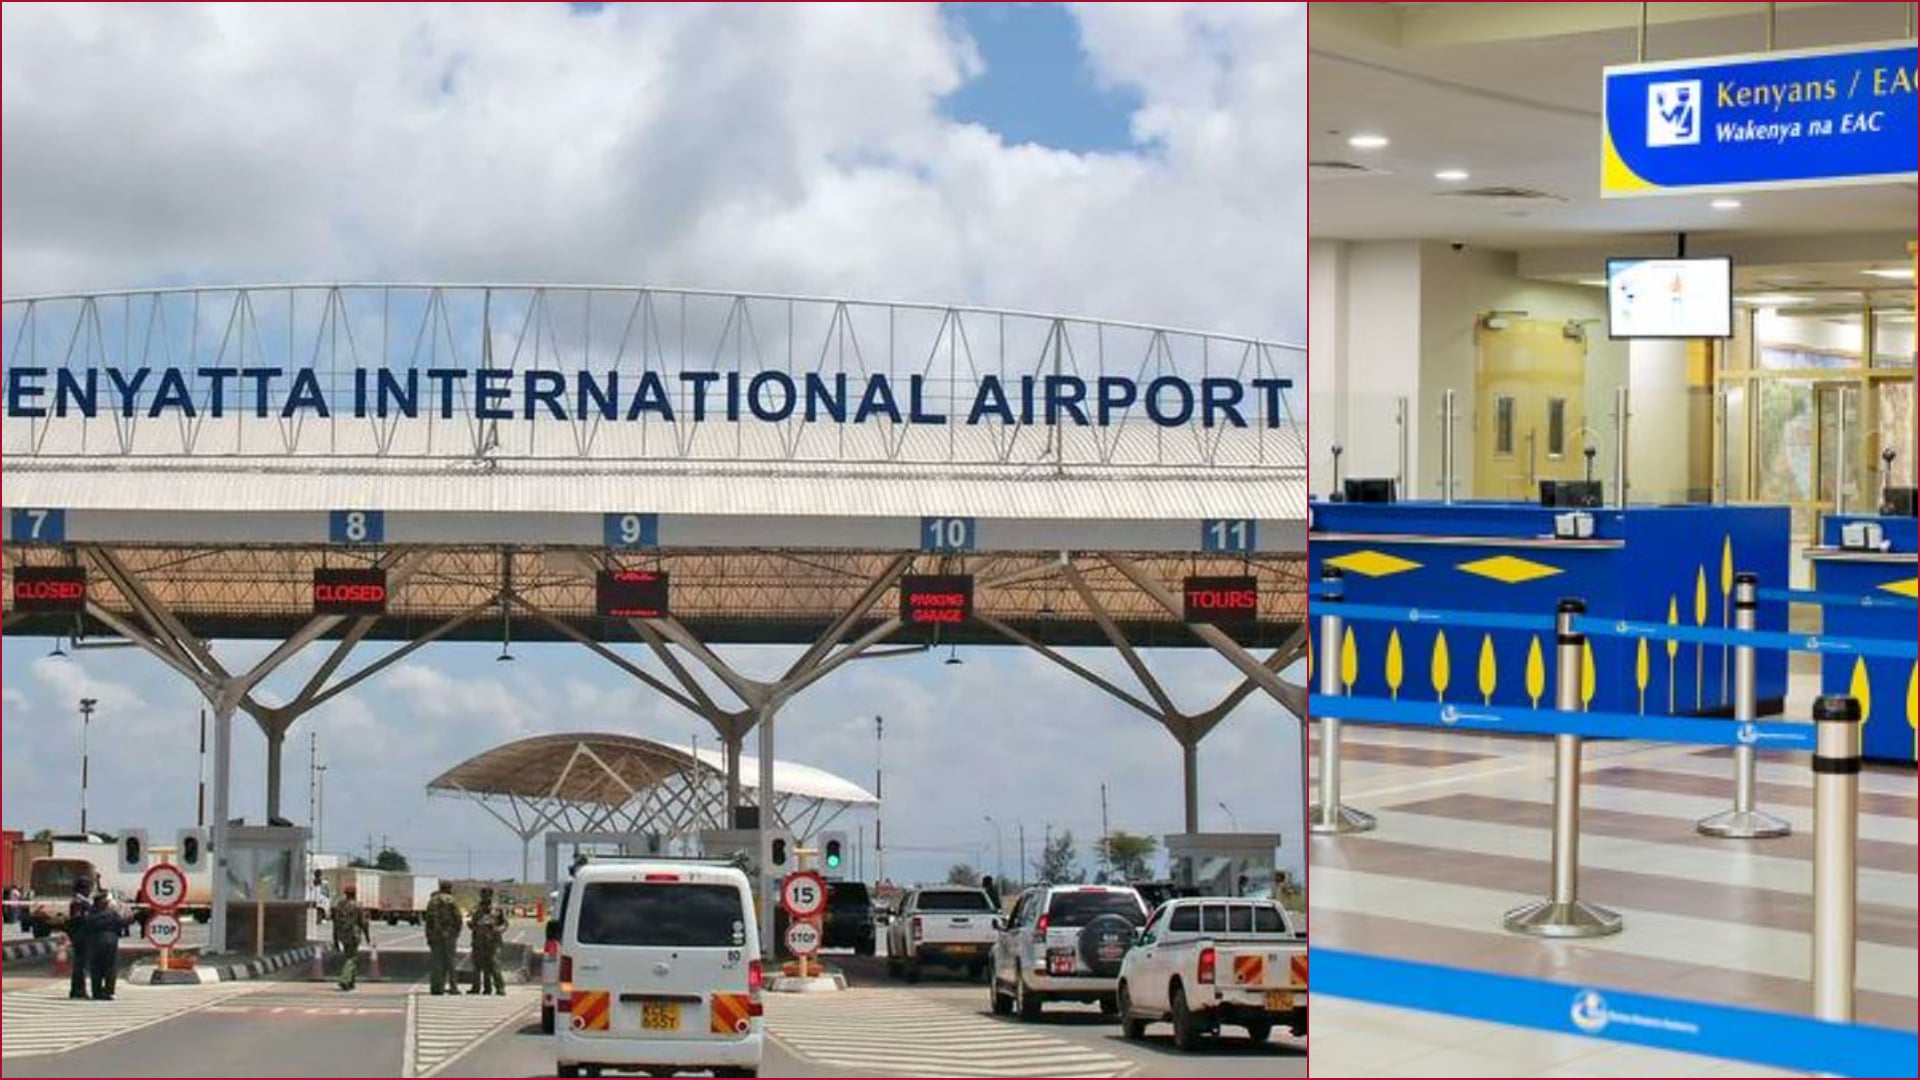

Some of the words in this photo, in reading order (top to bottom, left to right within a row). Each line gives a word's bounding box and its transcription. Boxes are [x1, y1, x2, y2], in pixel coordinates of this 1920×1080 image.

[1717, 79, 1837, 112] Kenyans
[1873, 66, 1918, 96] EA
[1715, 119, 1801, 145] Wakenya
[1808, 119, 1833, 136] na
[1840, 111, 1884, 134] EAC
[8, 367, 330, 418] ENYATTA
[354, 367, 946, 424] INTERNATIONAL
[967, 374, 1293, 428] AIRPORT
[27, 509, 48, 538] 7
[346, 511, 366, 540] 8
[619, 514, 641, 543] 9
[929, 519, 966, 547] 10
[1210, 520, 1247, 550] 11
[15, 580, 84, 599] CLOSED
[315, 584, 384, 601] CLOSED
[909, 592, 965, 606] PARKING
[1187, 589, 1256, 608] TOURS
[911, 608, 965, 623] GARAGE
[153, 879, 175, 897] 15
[793, 886, 815, 904] 15
[151, 924, 178, 936] STOP
[790, 932, 816, 944] STOP
